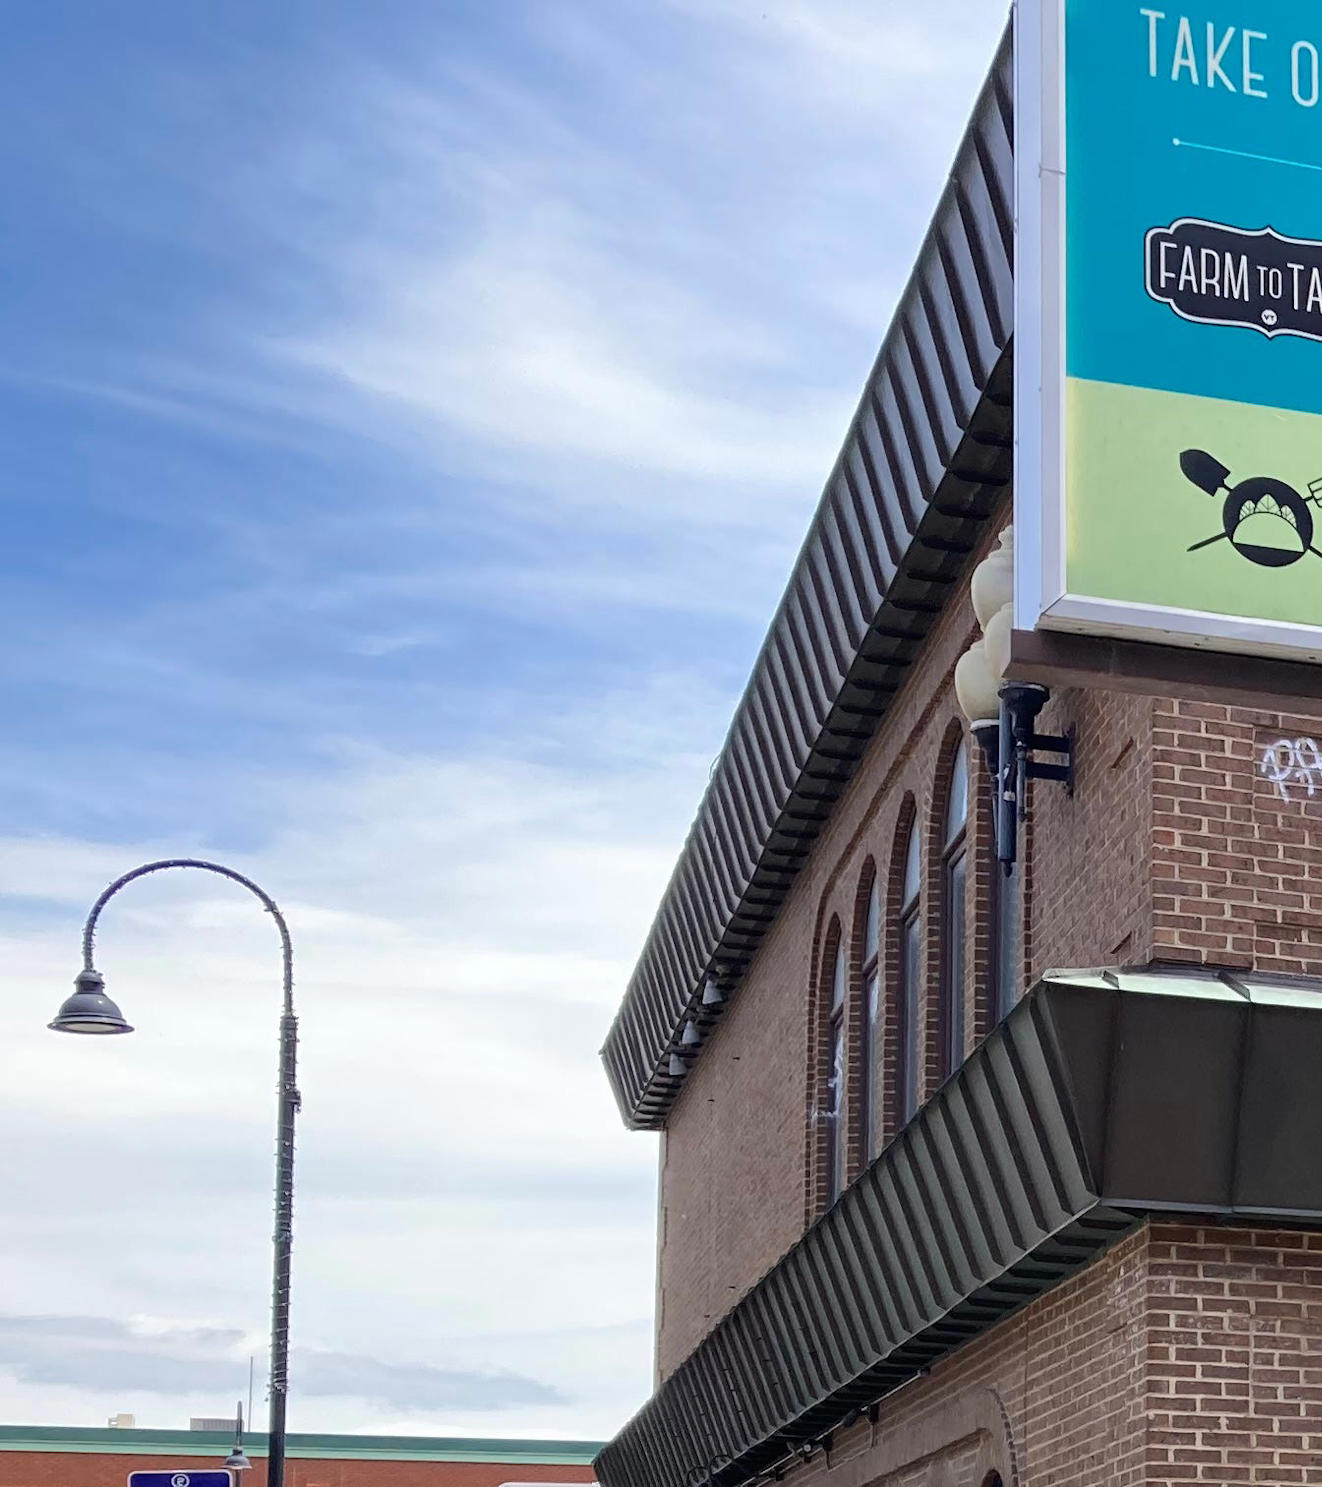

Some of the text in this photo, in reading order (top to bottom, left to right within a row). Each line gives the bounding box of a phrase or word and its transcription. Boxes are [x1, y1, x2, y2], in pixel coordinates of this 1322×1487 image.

[1140, 8, 1268, 98] TAKE
[1160, 241, 1249, 301] FARM
[1256, 265, 1282, 298] TO
